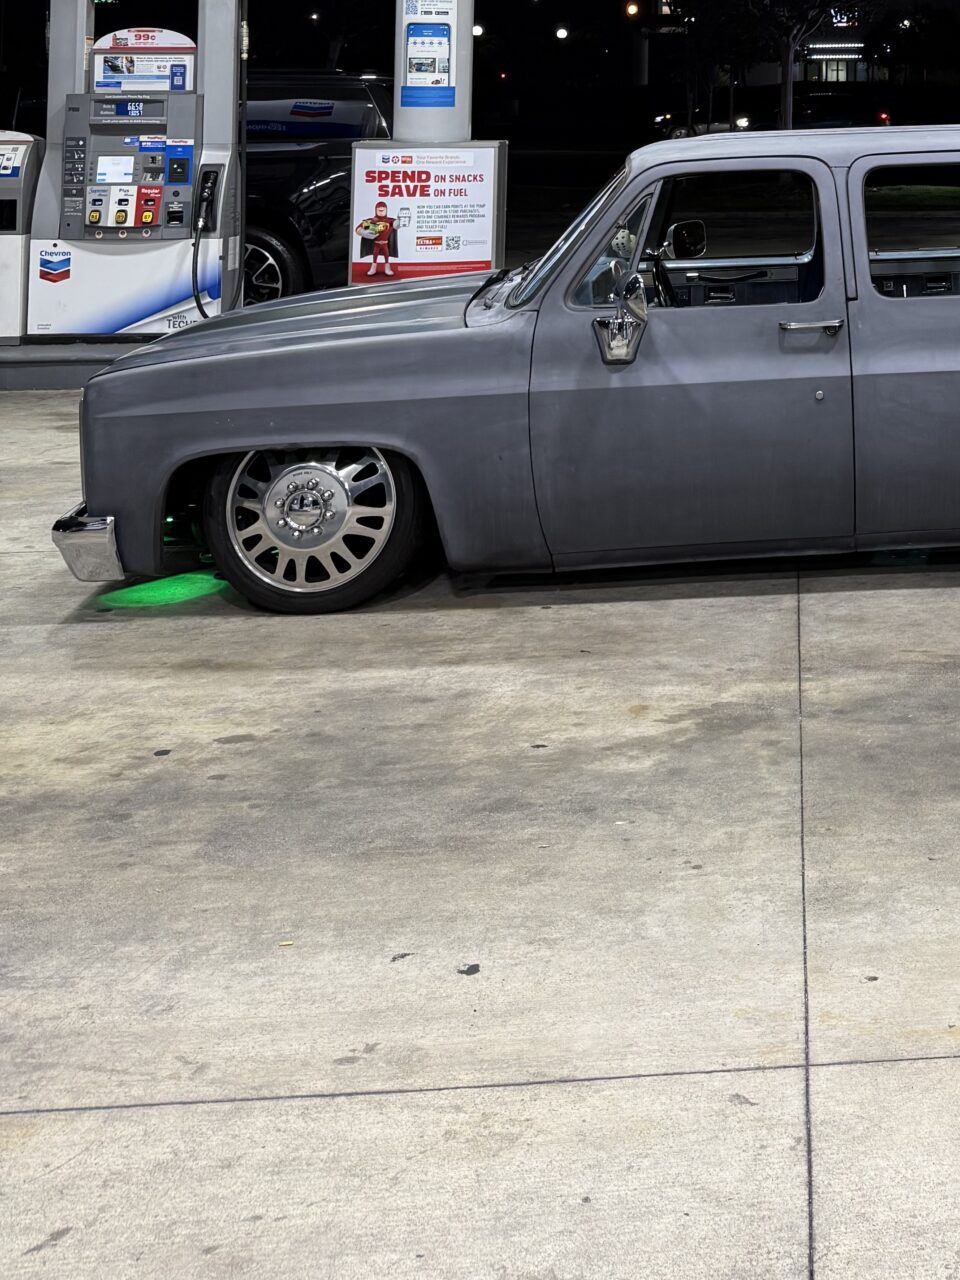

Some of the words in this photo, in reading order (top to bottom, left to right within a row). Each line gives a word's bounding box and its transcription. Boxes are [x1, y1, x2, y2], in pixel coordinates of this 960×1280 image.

[365, 170, 431, 183] SPEND
[434, 175, 446, 183] ON
[449, 174, 484, 183] SNACKS
[378, 184, 431, 197] SAVE
[433, 188, 446, 197] ON
[449, 188, 468, 197] FUEL
